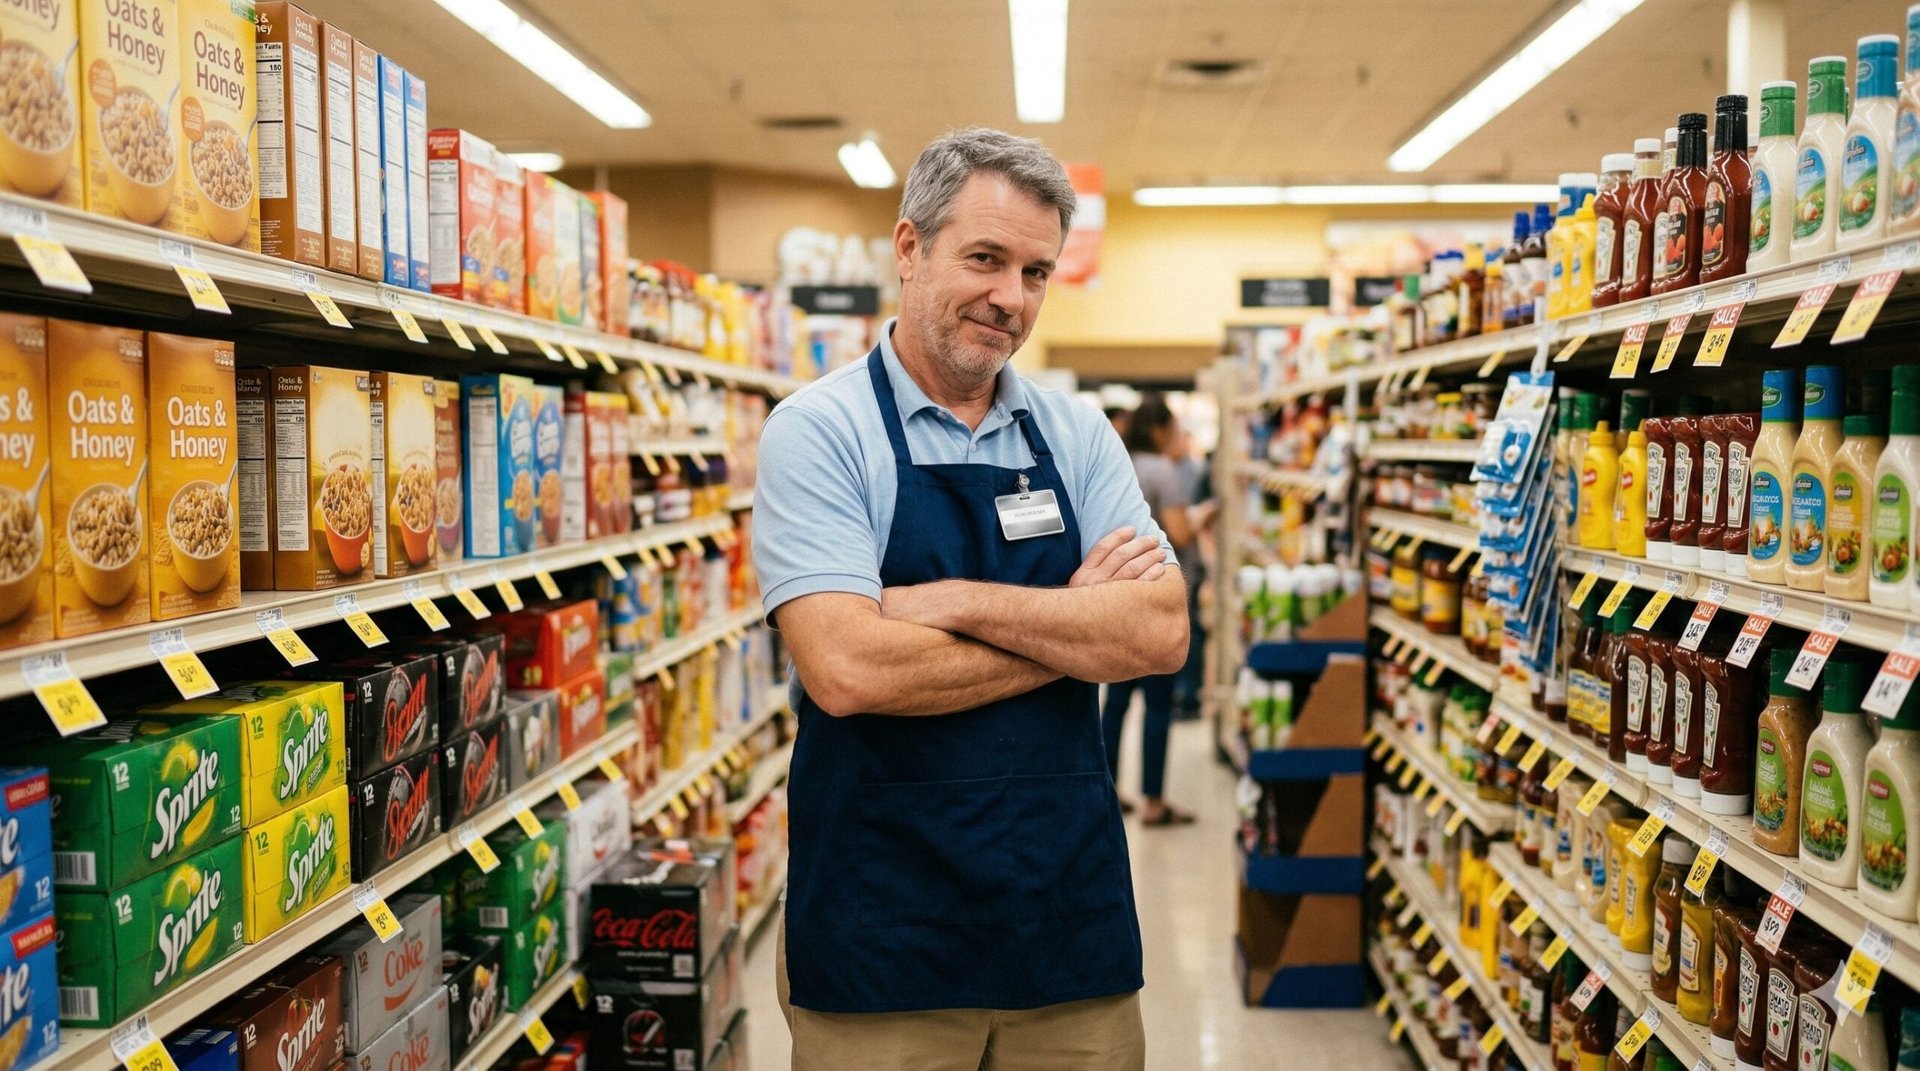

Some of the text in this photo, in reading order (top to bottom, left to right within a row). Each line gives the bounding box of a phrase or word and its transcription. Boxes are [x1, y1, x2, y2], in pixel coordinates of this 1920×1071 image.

[105, 0, 165, 38] Oats &
[256, 24, 272, 35] ney
[108, 19, 165, 75] Honey
[194, 30, 231, 70] Oats
[234, 47, 245, 76] &
[196, 61, 245, 110] Honey
[1667, 316, 1688, 335] SALE
[1713, 306, 1739, 325] SALE
[1624, 325, 1645, 342] SALE
[278, 383, 303, 392] Honey
[16, 387, 33, 422] &
[68, 390, 135, 425] Oats &
[167, 396, 227, 427] Oats &
[0, 432, 35, 469] ney
[71, 427, 135, 468] Honey
[170, 429, 227, 466] Honey
[1695, 604, 1715, 618] SALE
[1746, 617, 1768, 632] SALE
[1808, 633, 1832, 651] SALE
[1887, 655, 1917, 677] SALE
[363, 681, 373, 698] 12
[251, 715, 264, 734] 12
[280, 709, 328, 799] Sprite
[112, 762, 130, 785] 12
[336, 759, 344, 776] 12
[151, 748, 219, 859] Sprite
[364, 784, 374, 801] 12
[231, 805, 241, 824] 12
[255, 832, 269, 850] 12
[285, 815, 334, 912] Sprite
[35, 876, 51, 900] 12
[115, 894, 132, 918] 12
[1770, 897, 1792, 920] SALE
[153, 869, 222, 986] Sprite
[233, 921, 243, 940] 12
[358, 951, 369, 968] 12
[384, 940, 424, 988] Coke
[42, 1020, 56, 1044] 12
[244, 1024, 256, 1044] 12
